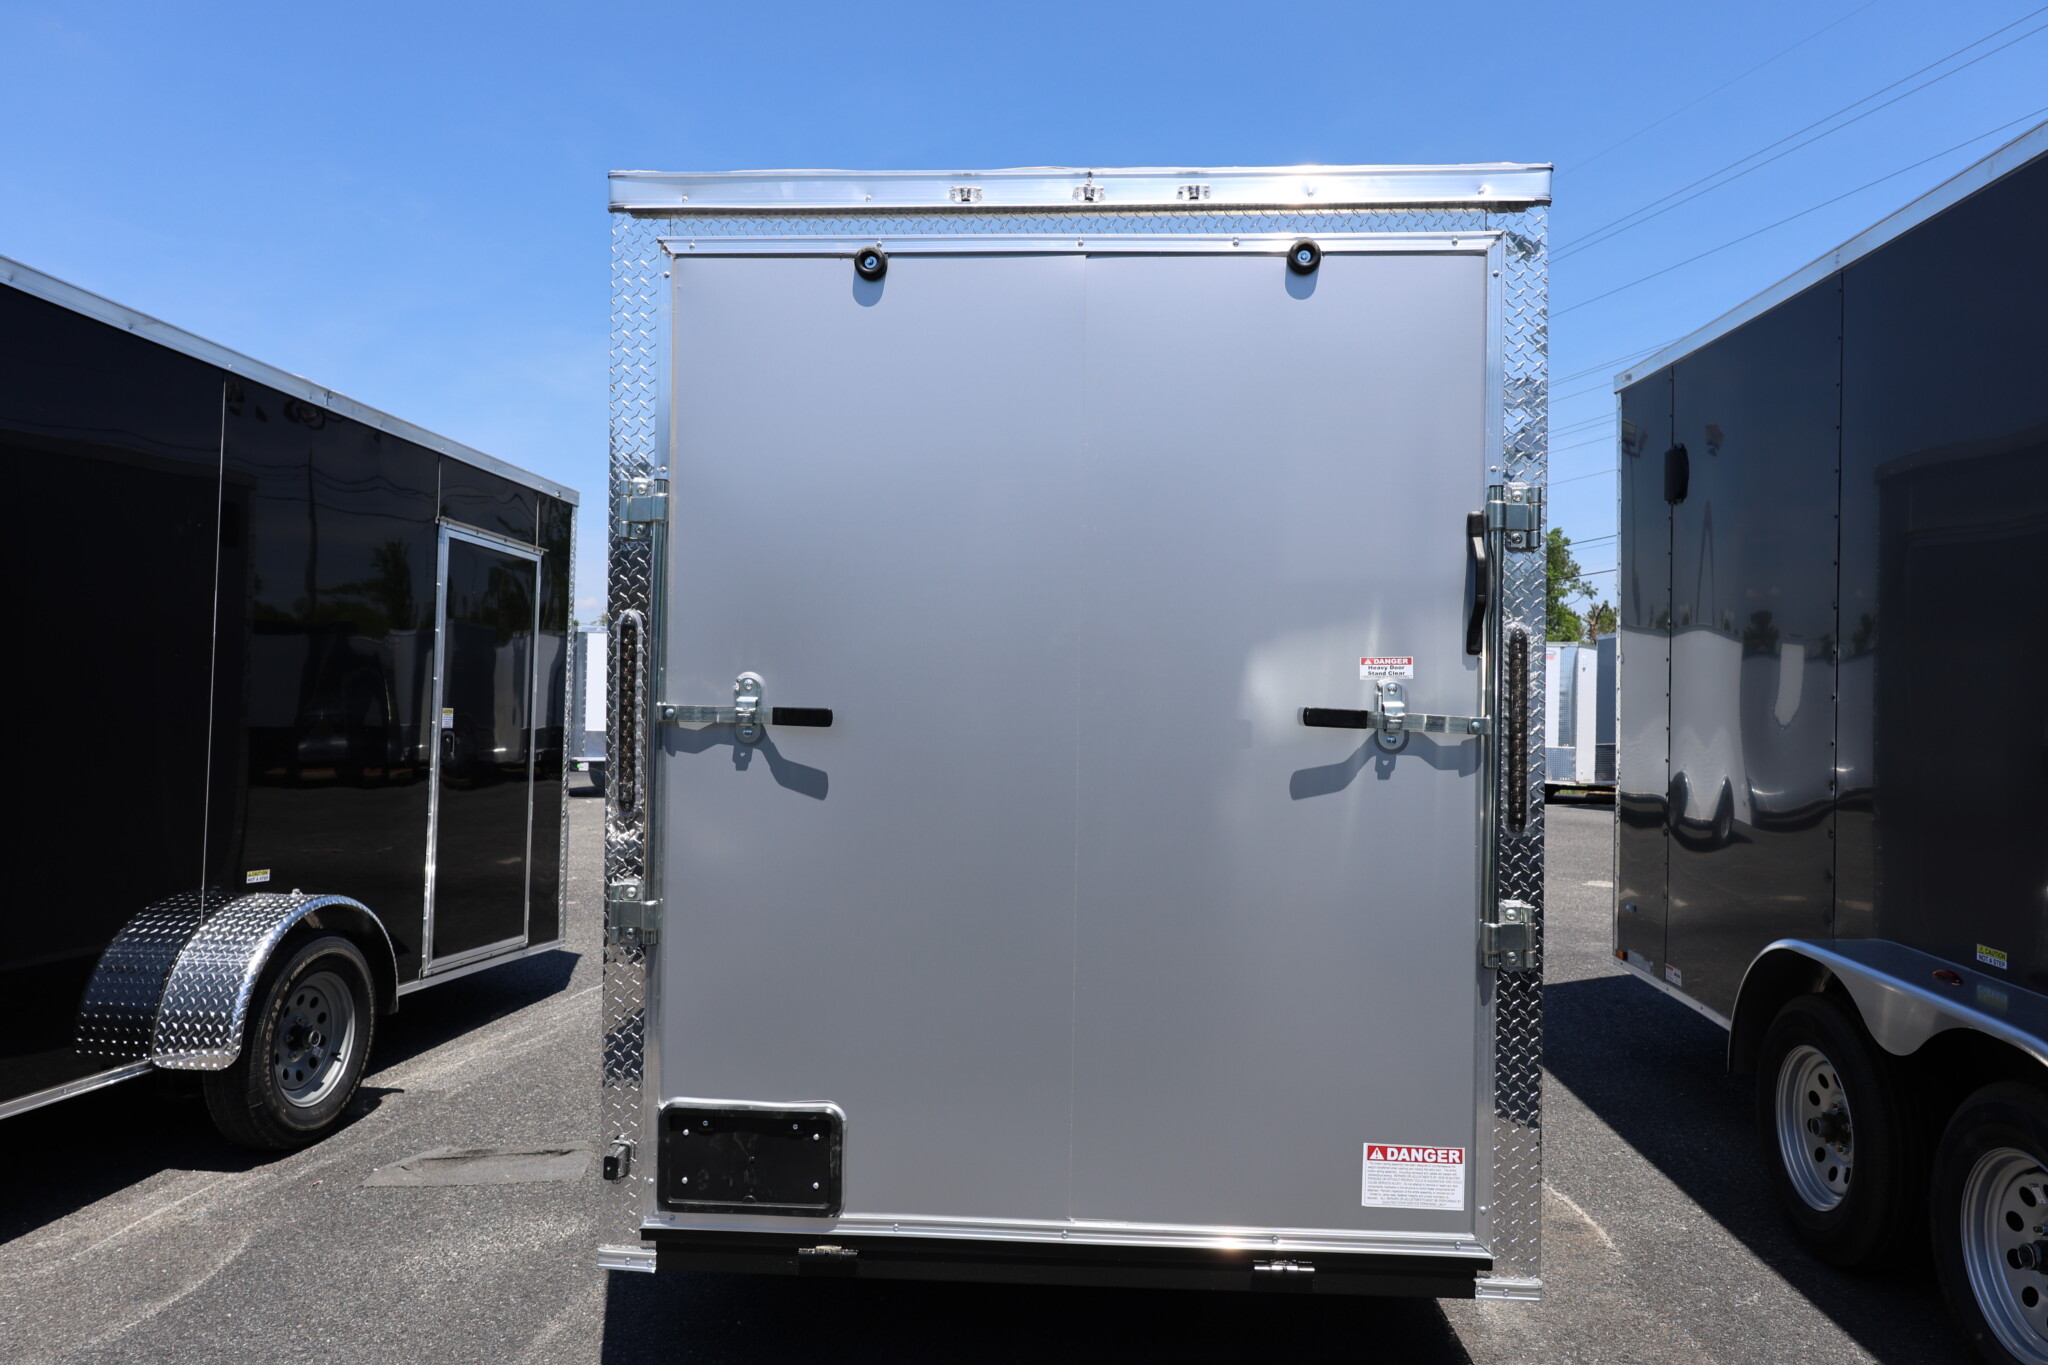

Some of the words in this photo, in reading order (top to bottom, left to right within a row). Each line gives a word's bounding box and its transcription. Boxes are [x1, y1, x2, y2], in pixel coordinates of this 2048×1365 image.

[1978, 953, 1988, 962] NOT
[1993, 958, 2006, 967] STEP
[1984, 947, 2006, 960] CAUTION
[1386, 1147, 1461, 1163] DANGER
